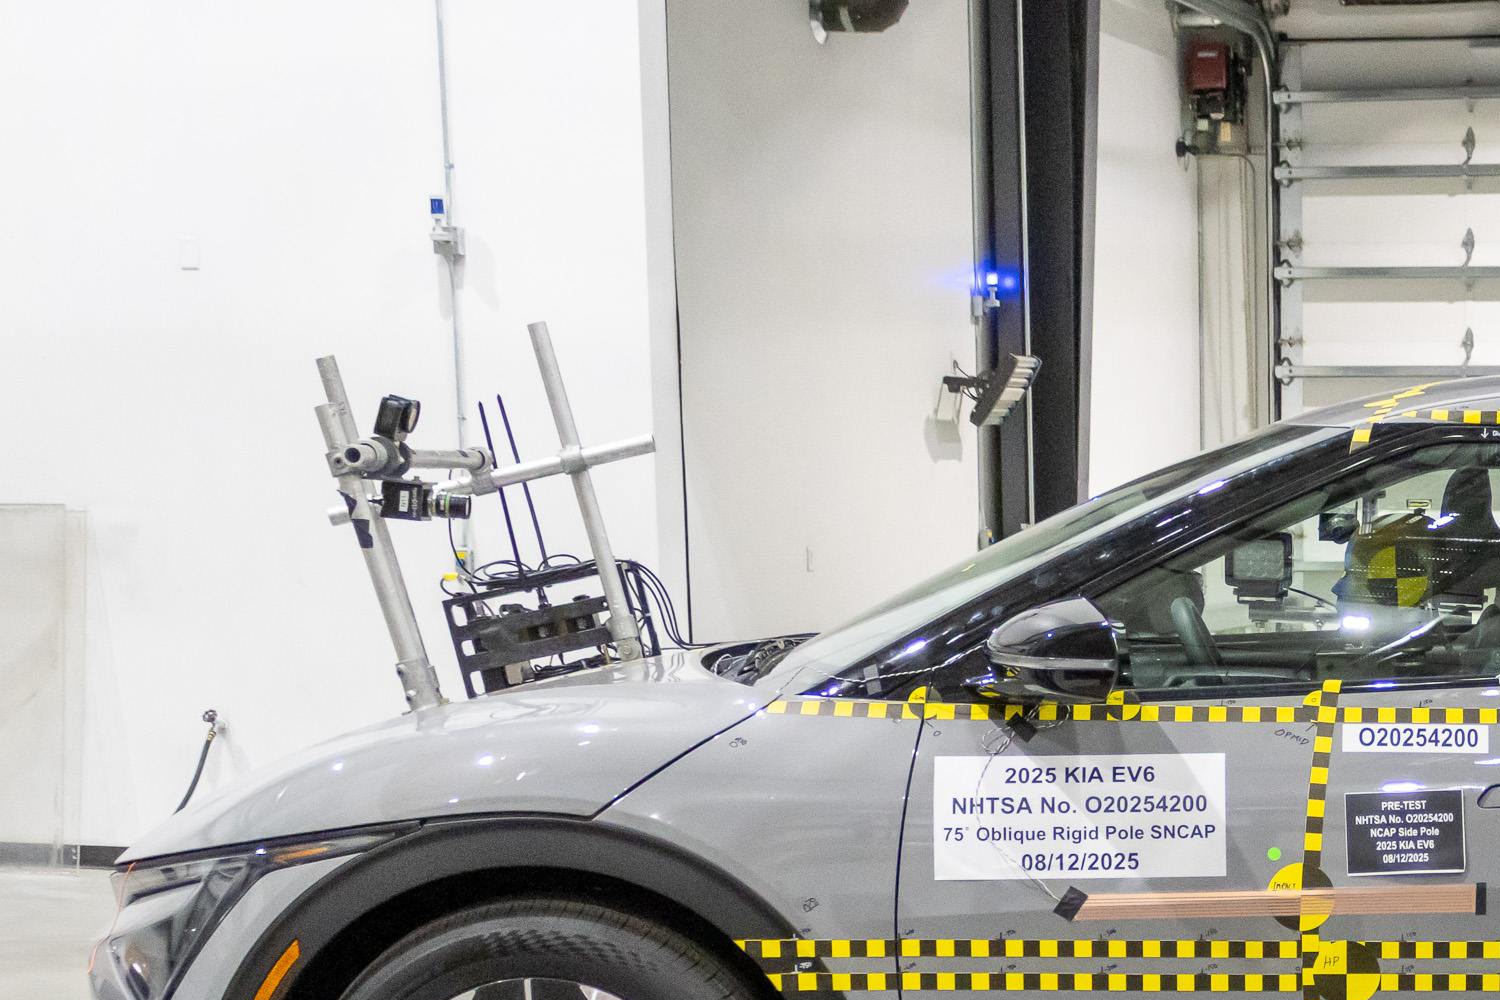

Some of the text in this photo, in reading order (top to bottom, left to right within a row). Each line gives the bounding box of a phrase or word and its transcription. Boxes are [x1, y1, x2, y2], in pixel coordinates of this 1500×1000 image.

[1359, 728, 1478, 747] O20254200
[1005, 766, 1154, 783] 2025 KIA EV6
[952, 795, 1207, 814] NHTSA No. O20254200
[1381, 800, 1427, 811] PRE-TEST
[1355, 813, 1454, 825] NHTSA No. O20254200
[943, 825, 1215, 844] 75° Oblique Rigid Pole SNCAP
[1370, 827, 1440, 838] NCAP Side Pole
[1376, 840, 1435, 851] 2025 KIA EV6
[1021, 852, 1139, 871] 08/12/2025
[1382, 853, 1429, 864] 08/12/2025
[1323, 955, 1340, 970] HP
